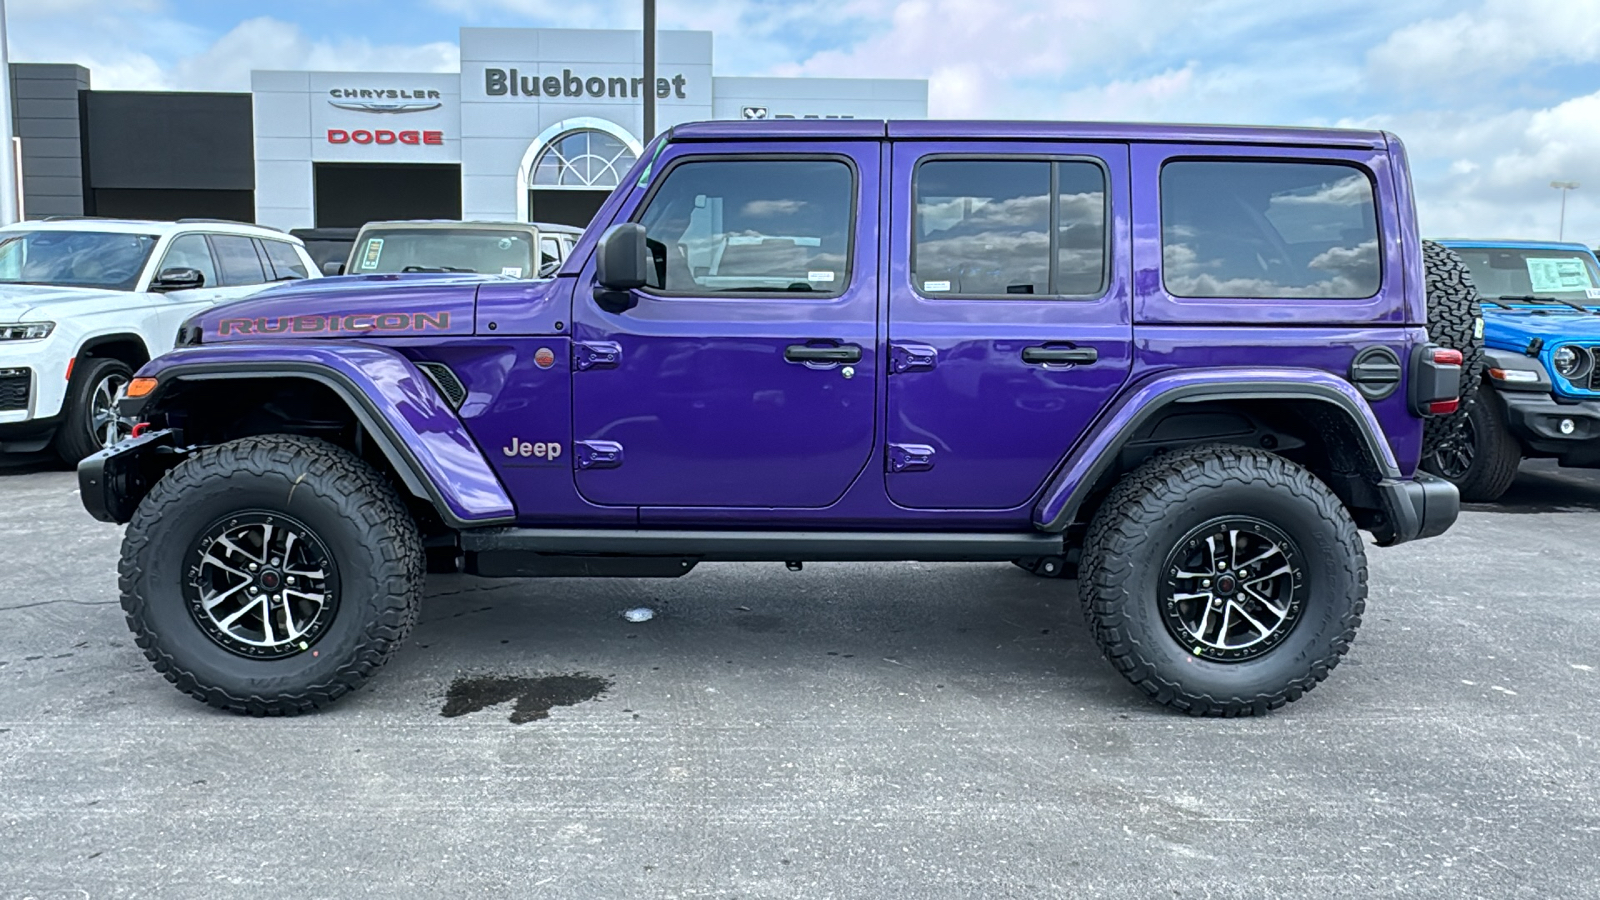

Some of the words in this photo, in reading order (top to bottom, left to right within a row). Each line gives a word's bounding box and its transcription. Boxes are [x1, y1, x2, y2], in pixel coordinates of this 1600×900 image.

[329, 88, 441, 99] CHRYSLER
[327, 129, 443, 145] DODGE
[217, 312, 450, 336] RUBICON
[503, 437, 562, 461] Jeep
